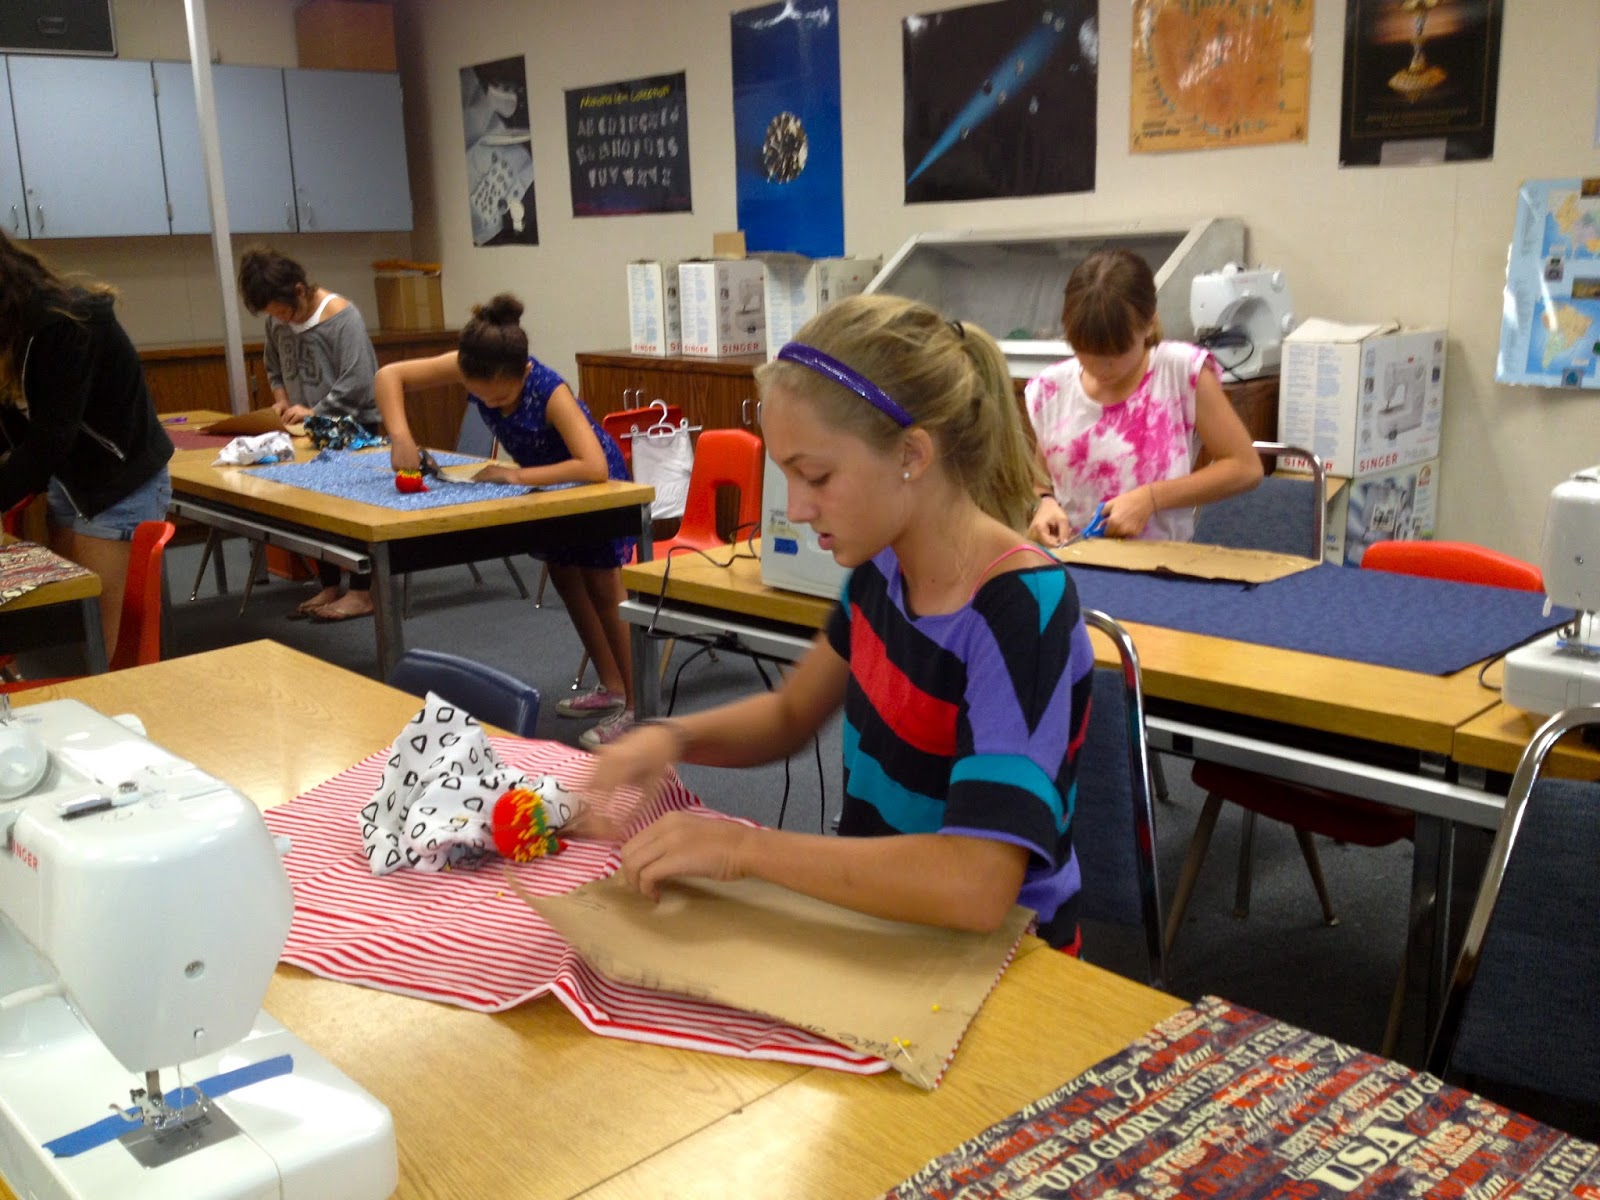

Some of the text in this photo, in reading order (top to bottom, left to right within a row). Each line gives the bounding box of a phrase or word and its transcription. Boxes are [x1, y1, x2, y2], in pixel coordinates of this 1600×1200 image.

[722, 343, 759, 354] SINGER
[1359, 453, 1398, 472] SINGER
[1114, 1045, 1212, 1107] Freedom
[1376, 1087, 1424, 1122] OLD
[1041, 1154, 1098, 1190] OLD
[1089, 1104, 1171, 1159] GLORY
[1281, 1146, 1332, 1181] United
[1305, 1126, 1419, 1193] USA
